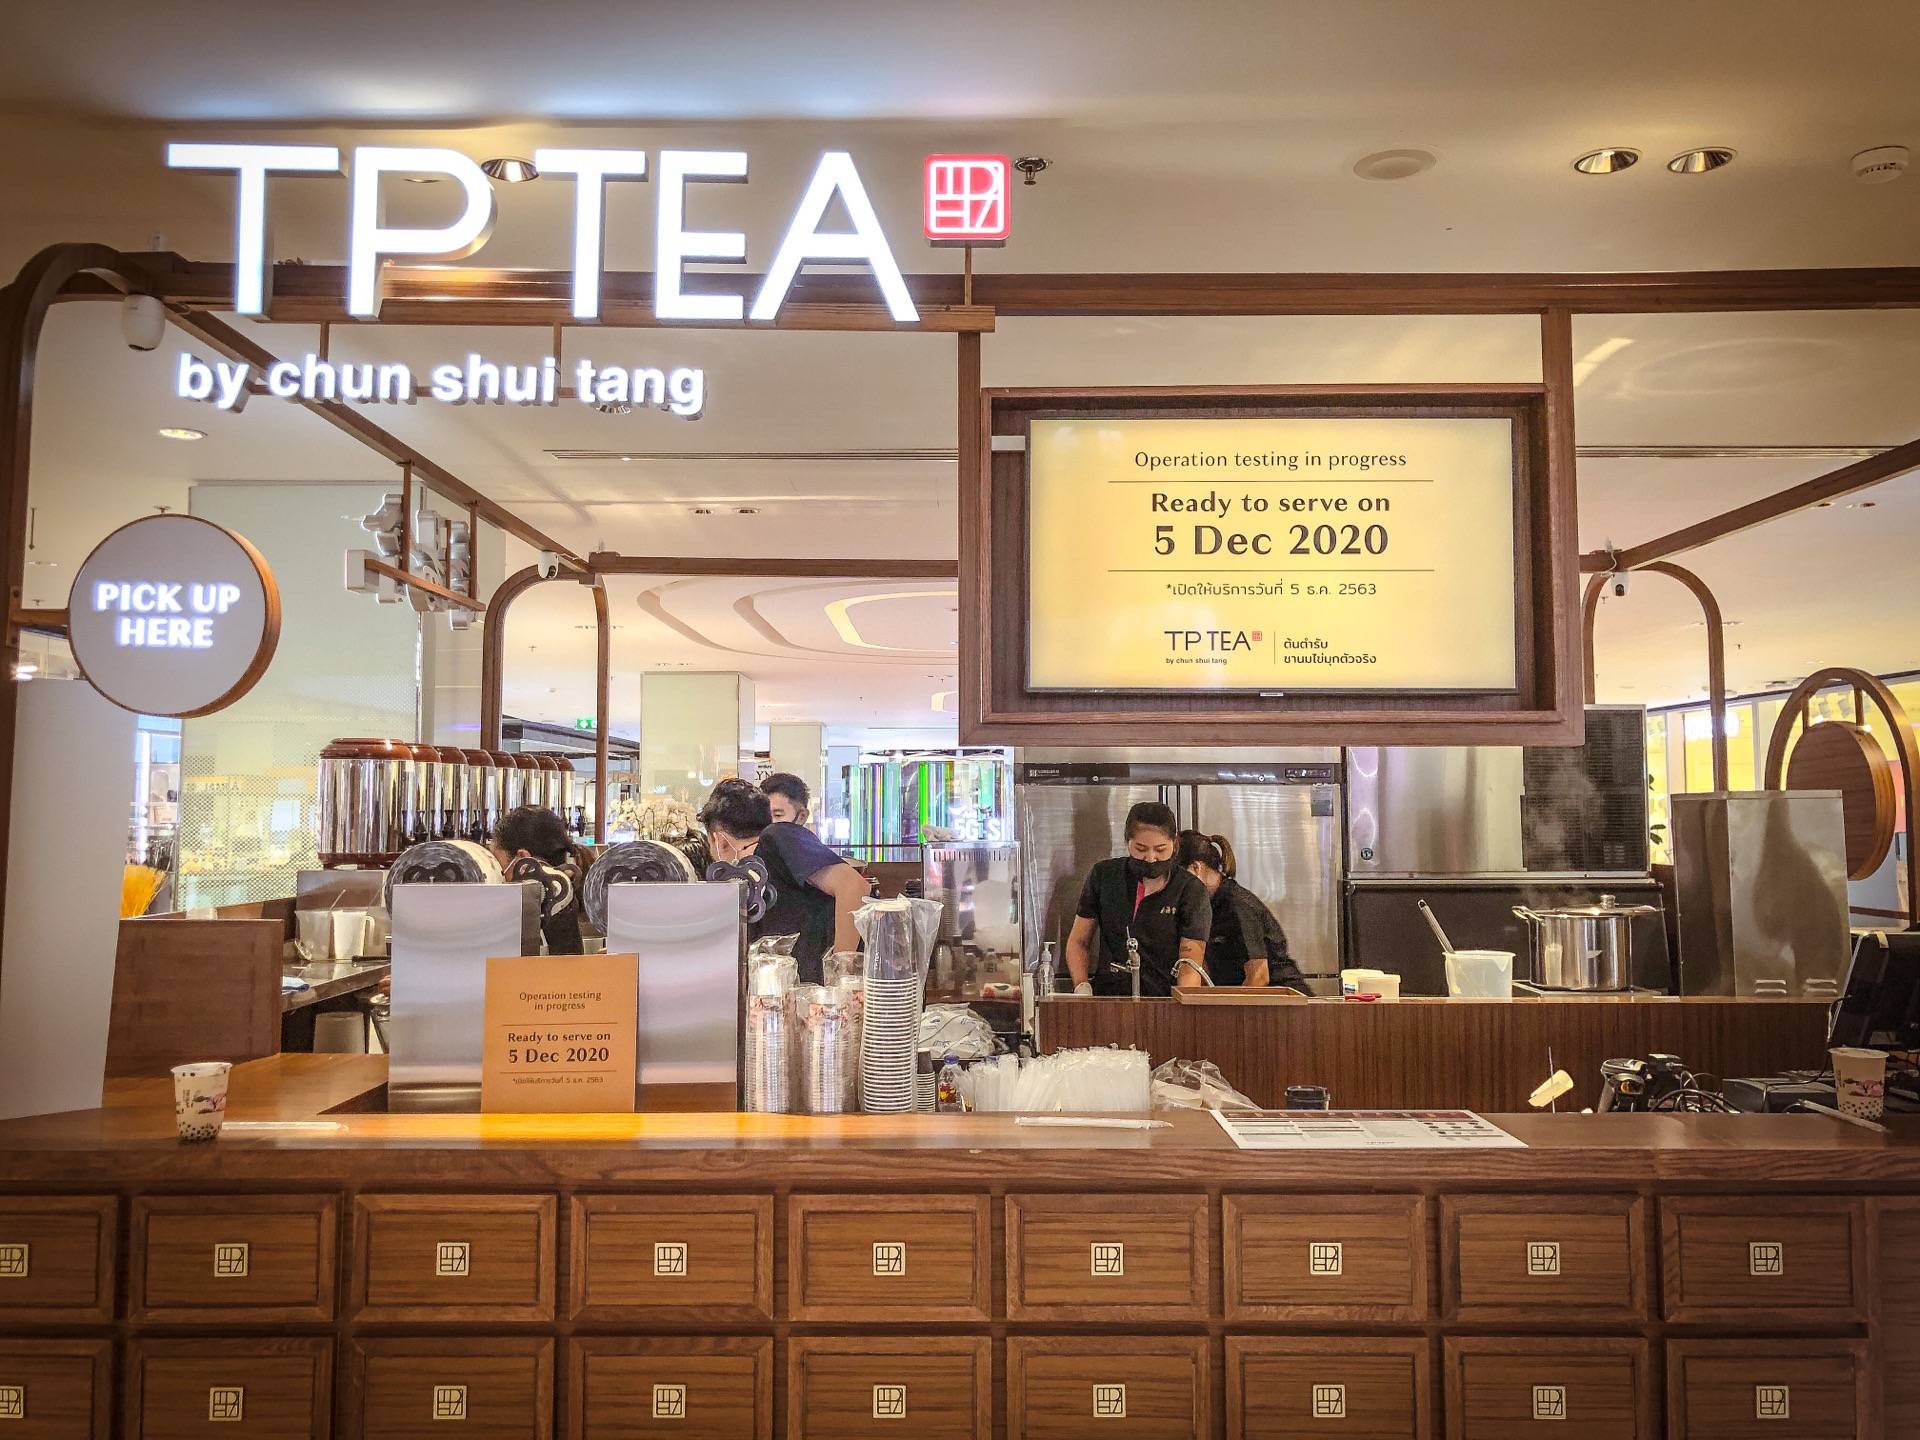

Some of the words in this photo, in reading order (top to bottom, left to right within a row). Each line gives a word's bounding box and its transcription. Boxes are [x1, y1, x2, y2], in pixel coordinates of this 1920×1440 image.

[167, 143, 492, 316] TP
[534, 148, 921, 323] TEA
[178, 353, 249, 409] by
[269, 353, 411, 400] chun
[432, 354, 556, 403] shui
[576, 359, 705, 416] tang
[1135, 451, 1227, 471] Operation
[1234, 451, 1298, 471] testing
[1305, 451, 1321, 466] in
[1329, 454, 1407, 471] progress
[1152, 490, 1231, 519] Ready
[1241, 493, 1269, 512] to
[1279, 497, 1348, 512] serve
[1358, 497, 1390, 512] on
[1154, 525, 1175, 555] 5
[1194, 525, 1272, 555] Dec
[1289, 524, 1389, 555] 2020
[1290, 583, 1300, 595] 5
[1338, 583, 1377, 595] 2563
[96, 583, 183, 612] PICK
[191, 584, 241, 614] UP
[119, 617, 214, 648] HERE
[1164, 631, 1202, 651] TP
[1206, 631, 1251, 651] TEA
[1284, 638, 1328, 650] ต้นตำรับ
[1165, 657, 1174, 665] by
[1211, 657, 1228, 665] tang
[1284, 653, 1377, 666] ชานมไข่มุกตัวจริง
[519, 991, 566, 1001] Operation
[569, 991, 602, 1001] testing
[534, 1002, 544, 1011] in
[546, 1002, 586, 1012] progress
[508, 1032, 543, 1044] Ready
[547, 1032, 559, 1041] to
[562, 1032, 592, 1041] serve
[596, 1031, 611, 1041] on
[508, 1049, 518, 1063] 5
[526, 1049, 560, 1063] Dec
[566, 1047, 610, 1062] 2020
